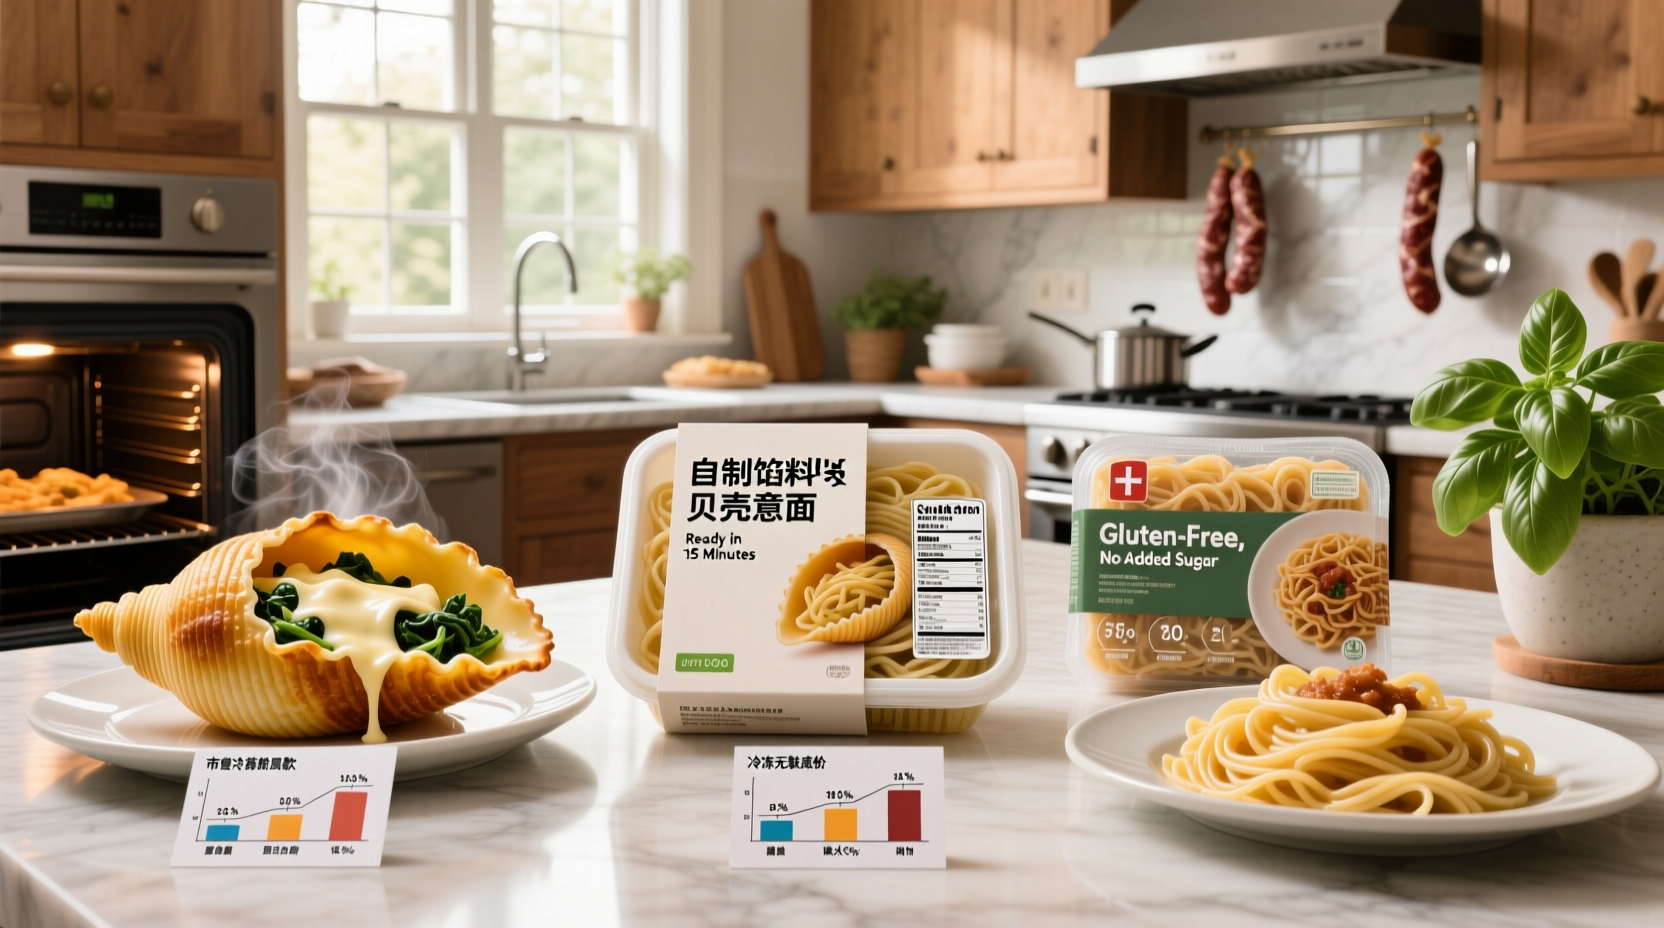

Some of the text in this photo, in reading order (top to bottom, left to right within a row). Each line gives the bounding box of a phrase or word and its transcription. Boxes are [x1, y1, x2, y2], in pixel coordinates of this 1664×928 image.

[687, 491, 817, 523] 贝壳意面
[686, 532, 742, 548] Ready in
[1099, 522, 1245, 552] Gluten-Free,
[683, 548, 699, 560] 15
[1100, 550, 1219, 571] No Added Sugar
